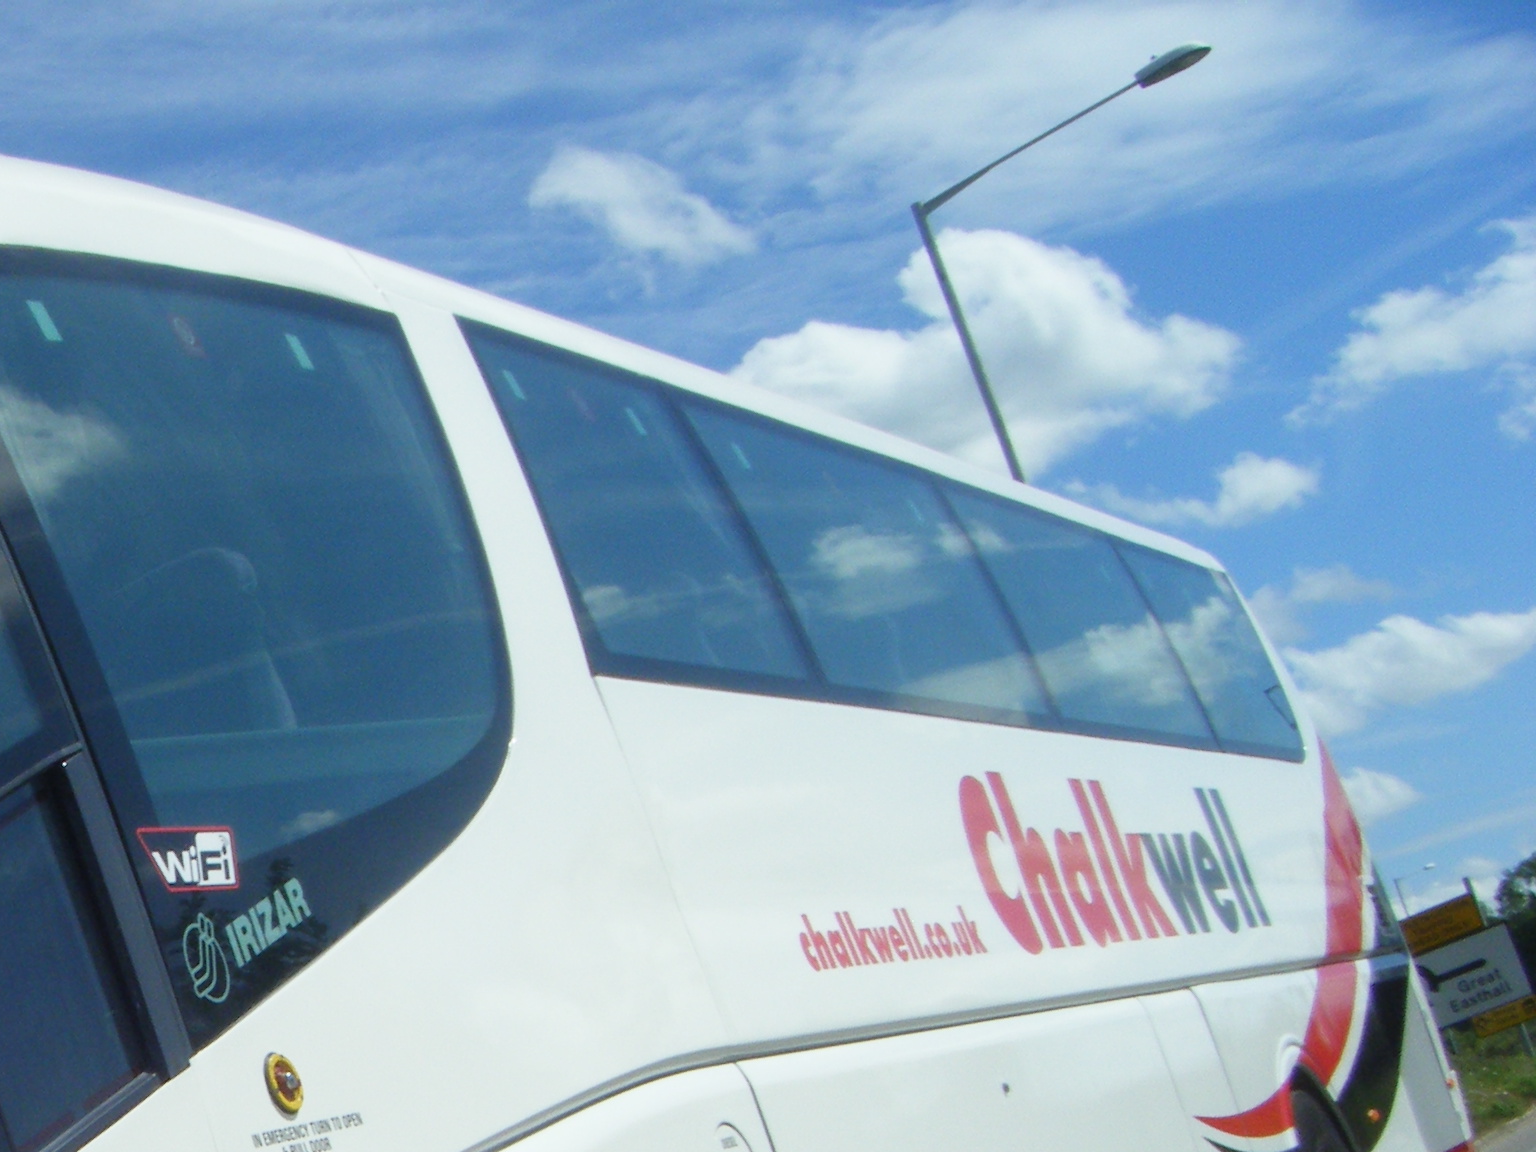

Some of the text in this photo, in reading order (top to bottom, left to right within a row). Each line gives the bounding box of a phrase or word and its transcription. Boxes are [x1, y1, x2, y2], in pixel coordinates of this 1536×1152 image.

[958, 771, 1272, 955] Chalkwell
[225, 877, 312, 968] IRIZAR
[799, 905, 988, 972] chalkwell.co.uk
[1450, 981, 1512, 1013] Easthall
[1457, 967, 1502, 994] Great
[251, 1112, 363, 1148] IN EMERGENCY TURN TO OPEN
